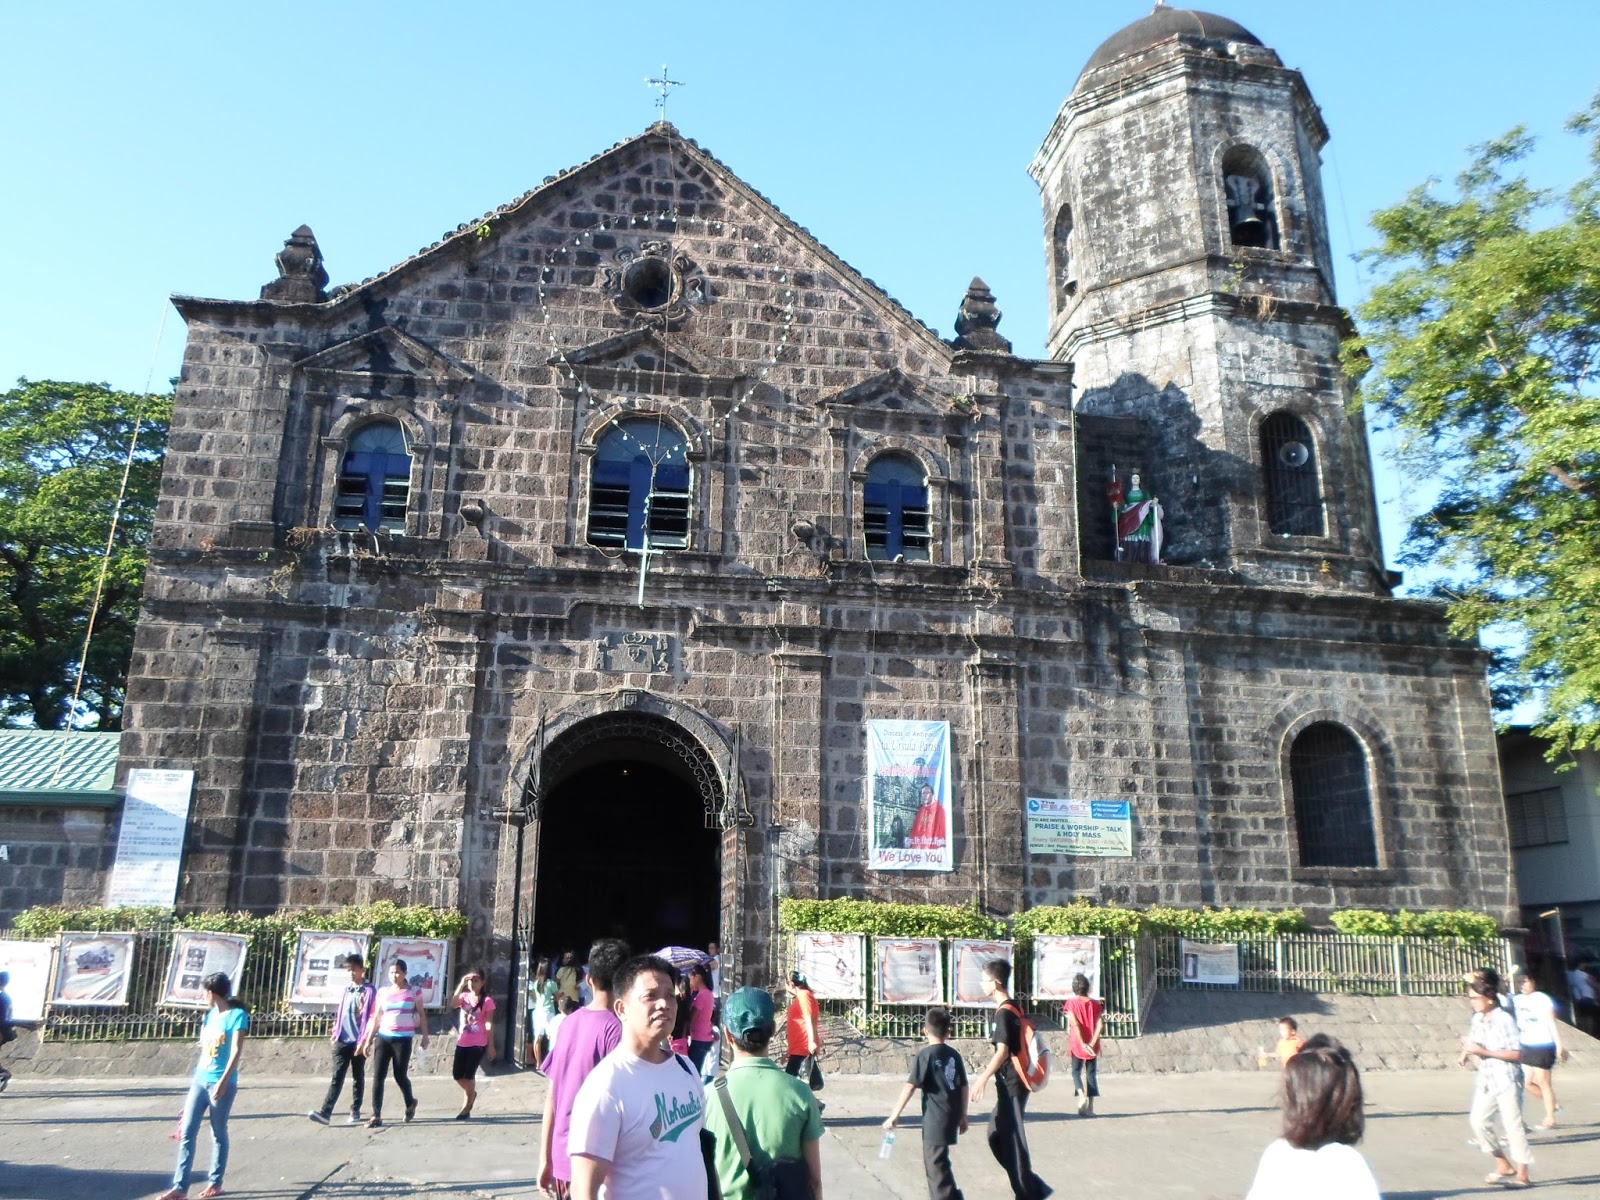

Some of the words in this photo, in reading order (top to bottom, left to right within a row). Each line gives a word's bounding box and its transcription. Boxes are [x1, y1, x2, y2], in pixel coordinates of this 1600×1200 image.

[883, 729, 903, 737] Diocese
[913, 730, 938, 738] Antipolo
[891, 739, 916, 752] Ursula
[879, 850, 895, 862] We
[898, 850, 922, 863] Love
[925, 851, 943, 863] You
